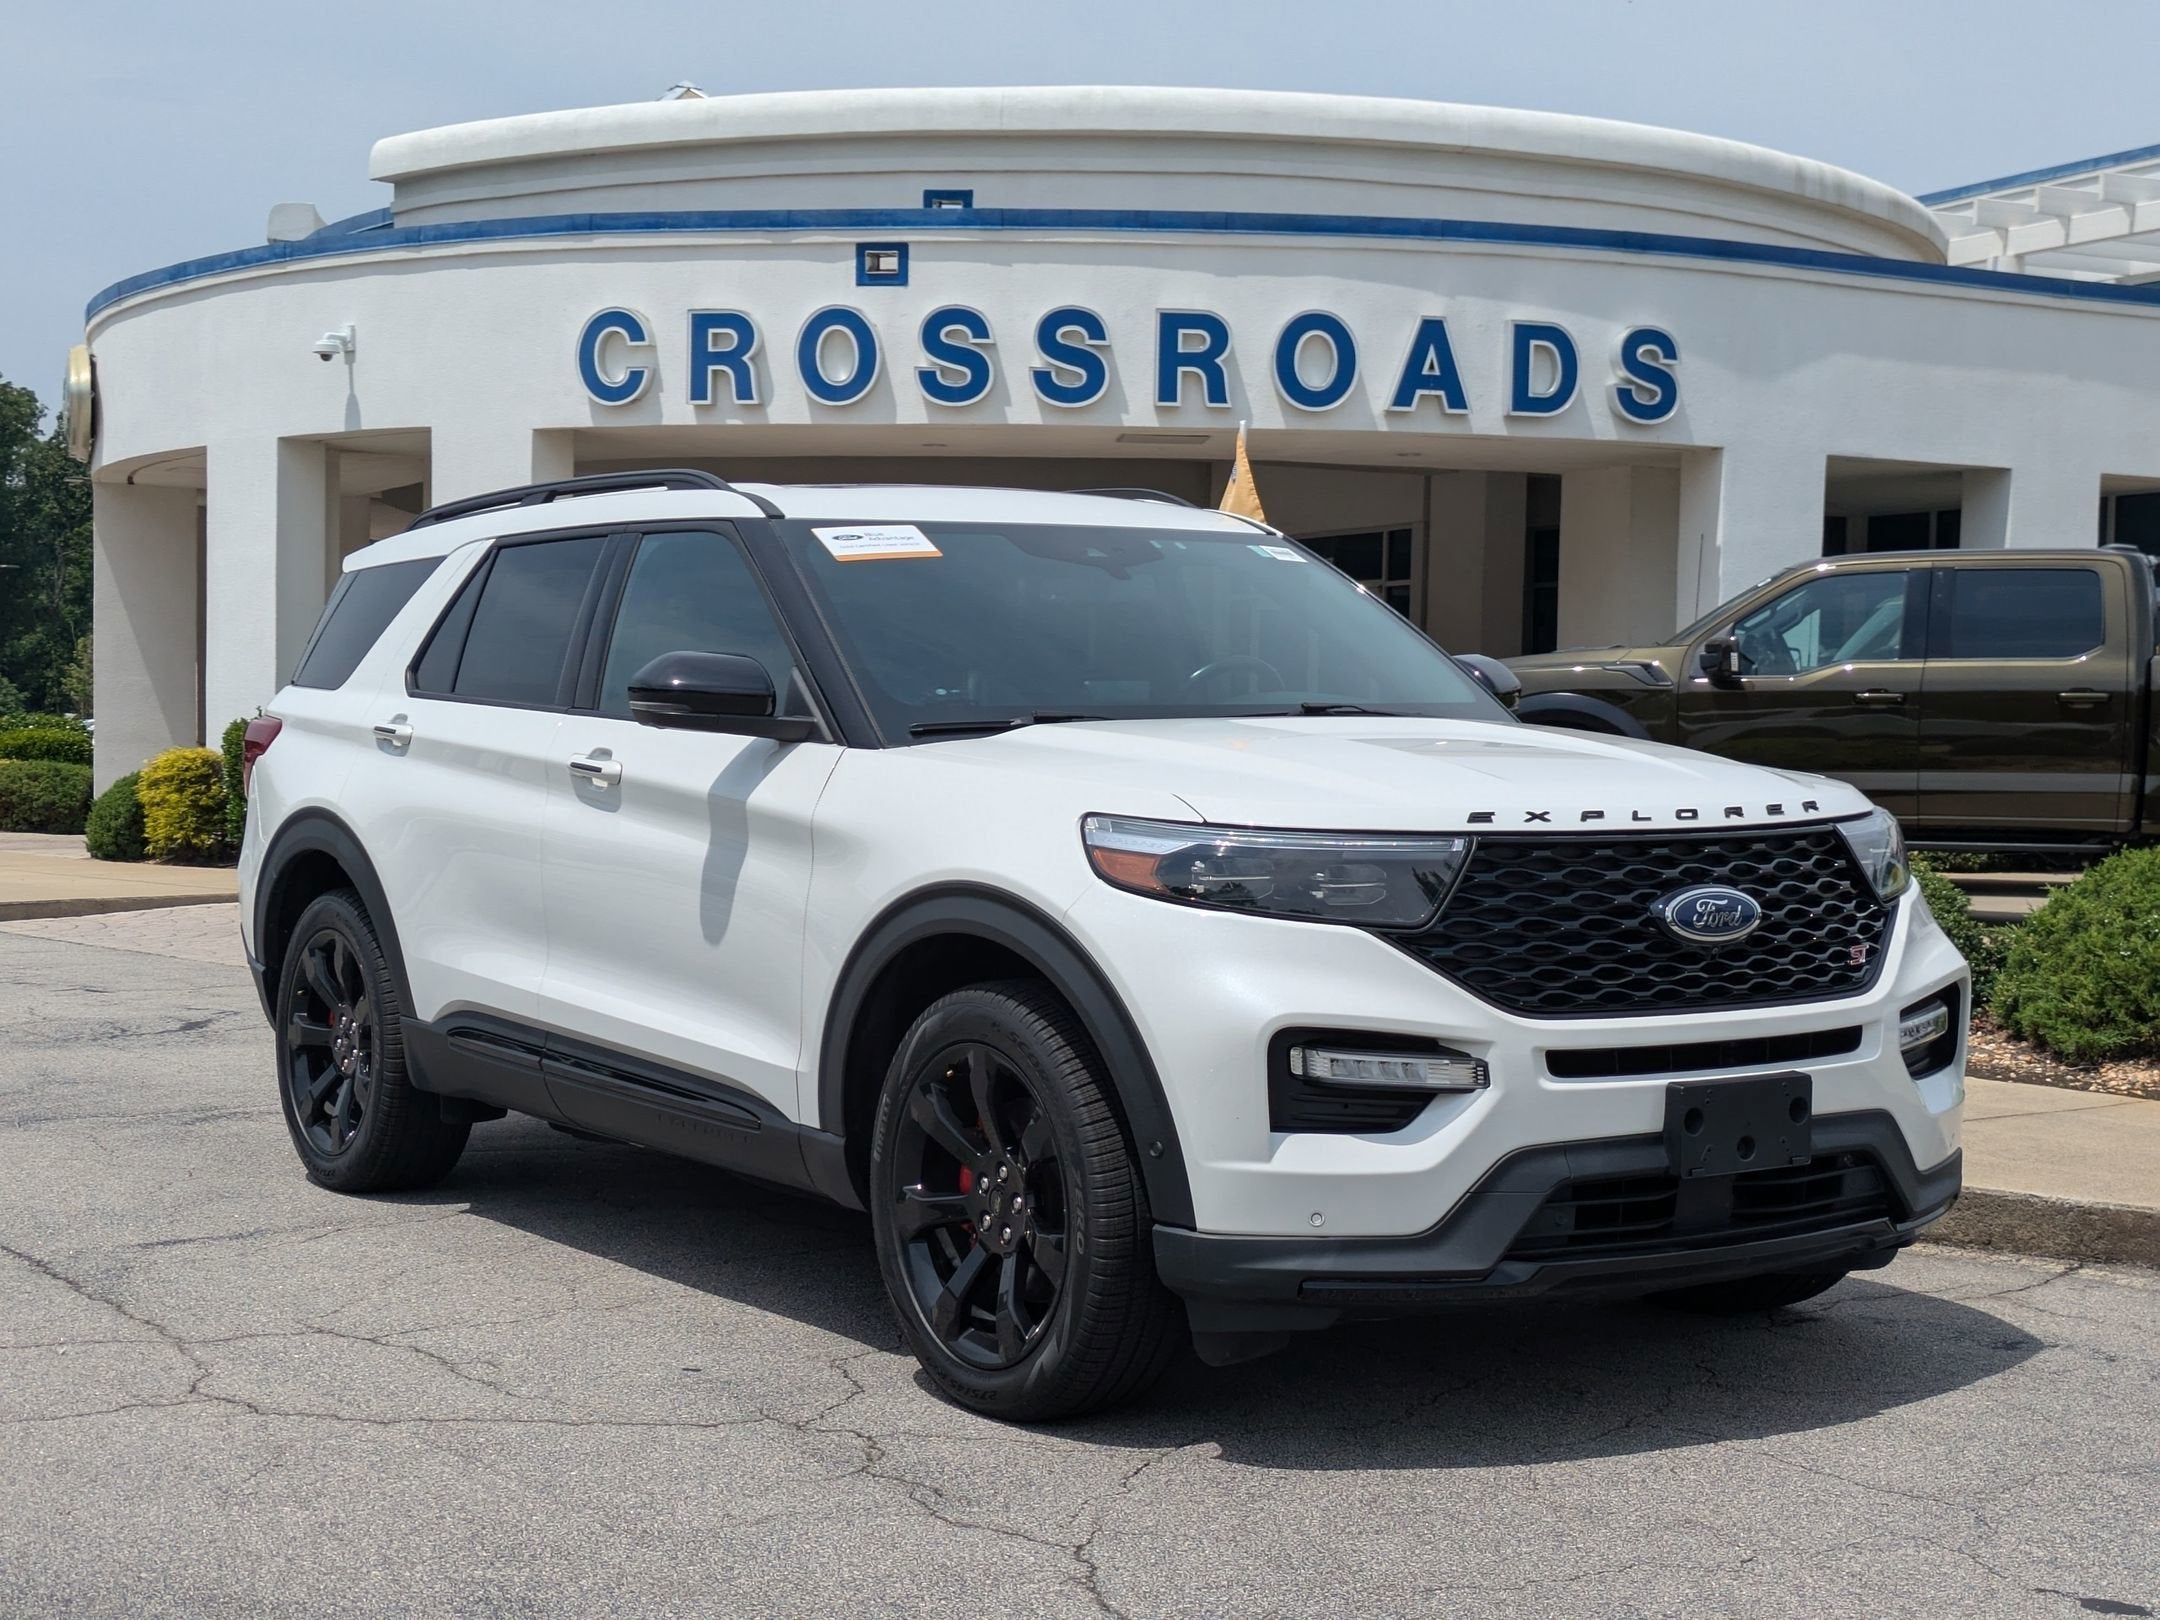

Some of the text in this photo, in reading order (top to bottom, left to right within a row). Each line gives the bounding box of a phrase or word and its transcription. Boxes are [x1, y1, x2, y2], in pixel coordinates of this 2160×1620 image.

[575, 303, 1681, 425] CROSSROADS
[1466, 799, 1820, 824] EXPLORER
[1693, 898, 1743, 928] Ford
[1071, 1166, 1086, 1255] ZERO
